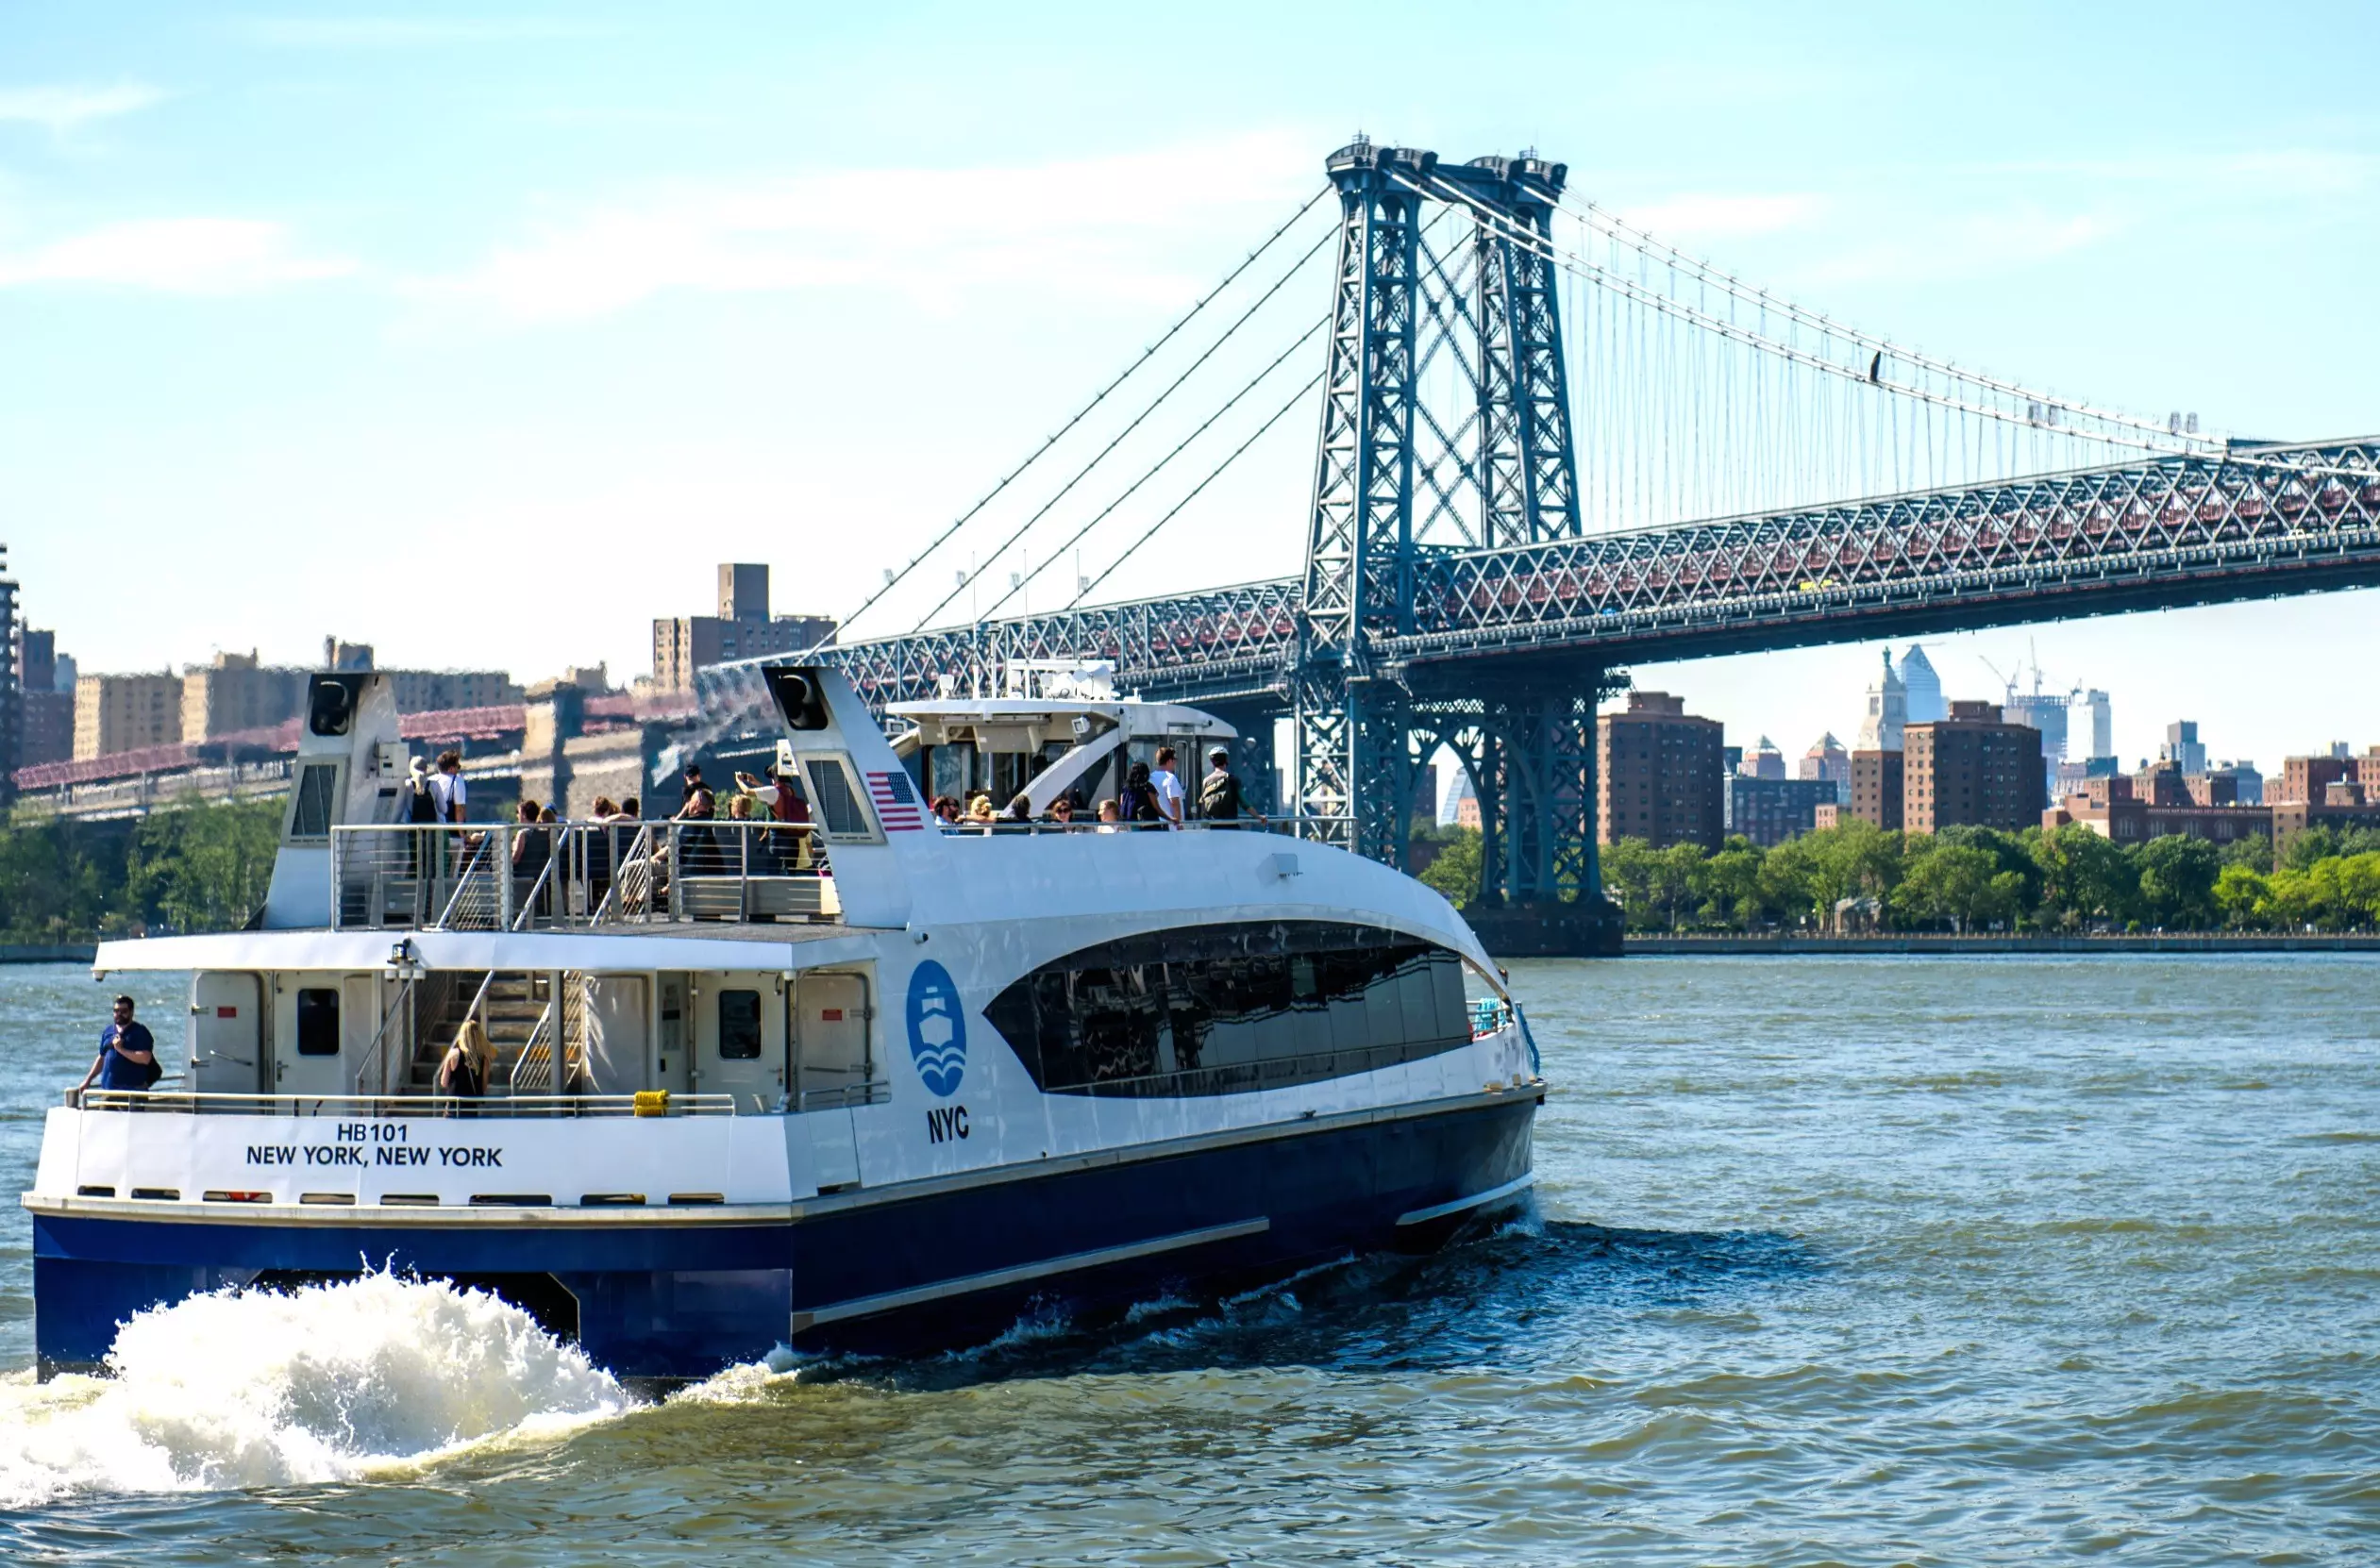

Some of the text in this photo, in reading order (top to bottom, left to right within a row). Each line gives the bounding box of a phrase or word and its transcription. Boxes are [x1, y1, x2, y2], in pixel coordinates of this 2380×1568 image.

[337, 1123, 408, 1143] HB101
[927, 1105, 969, 1144] NYC
[246, 1145, 504, 1168] NEW YORK, NEW YORK
